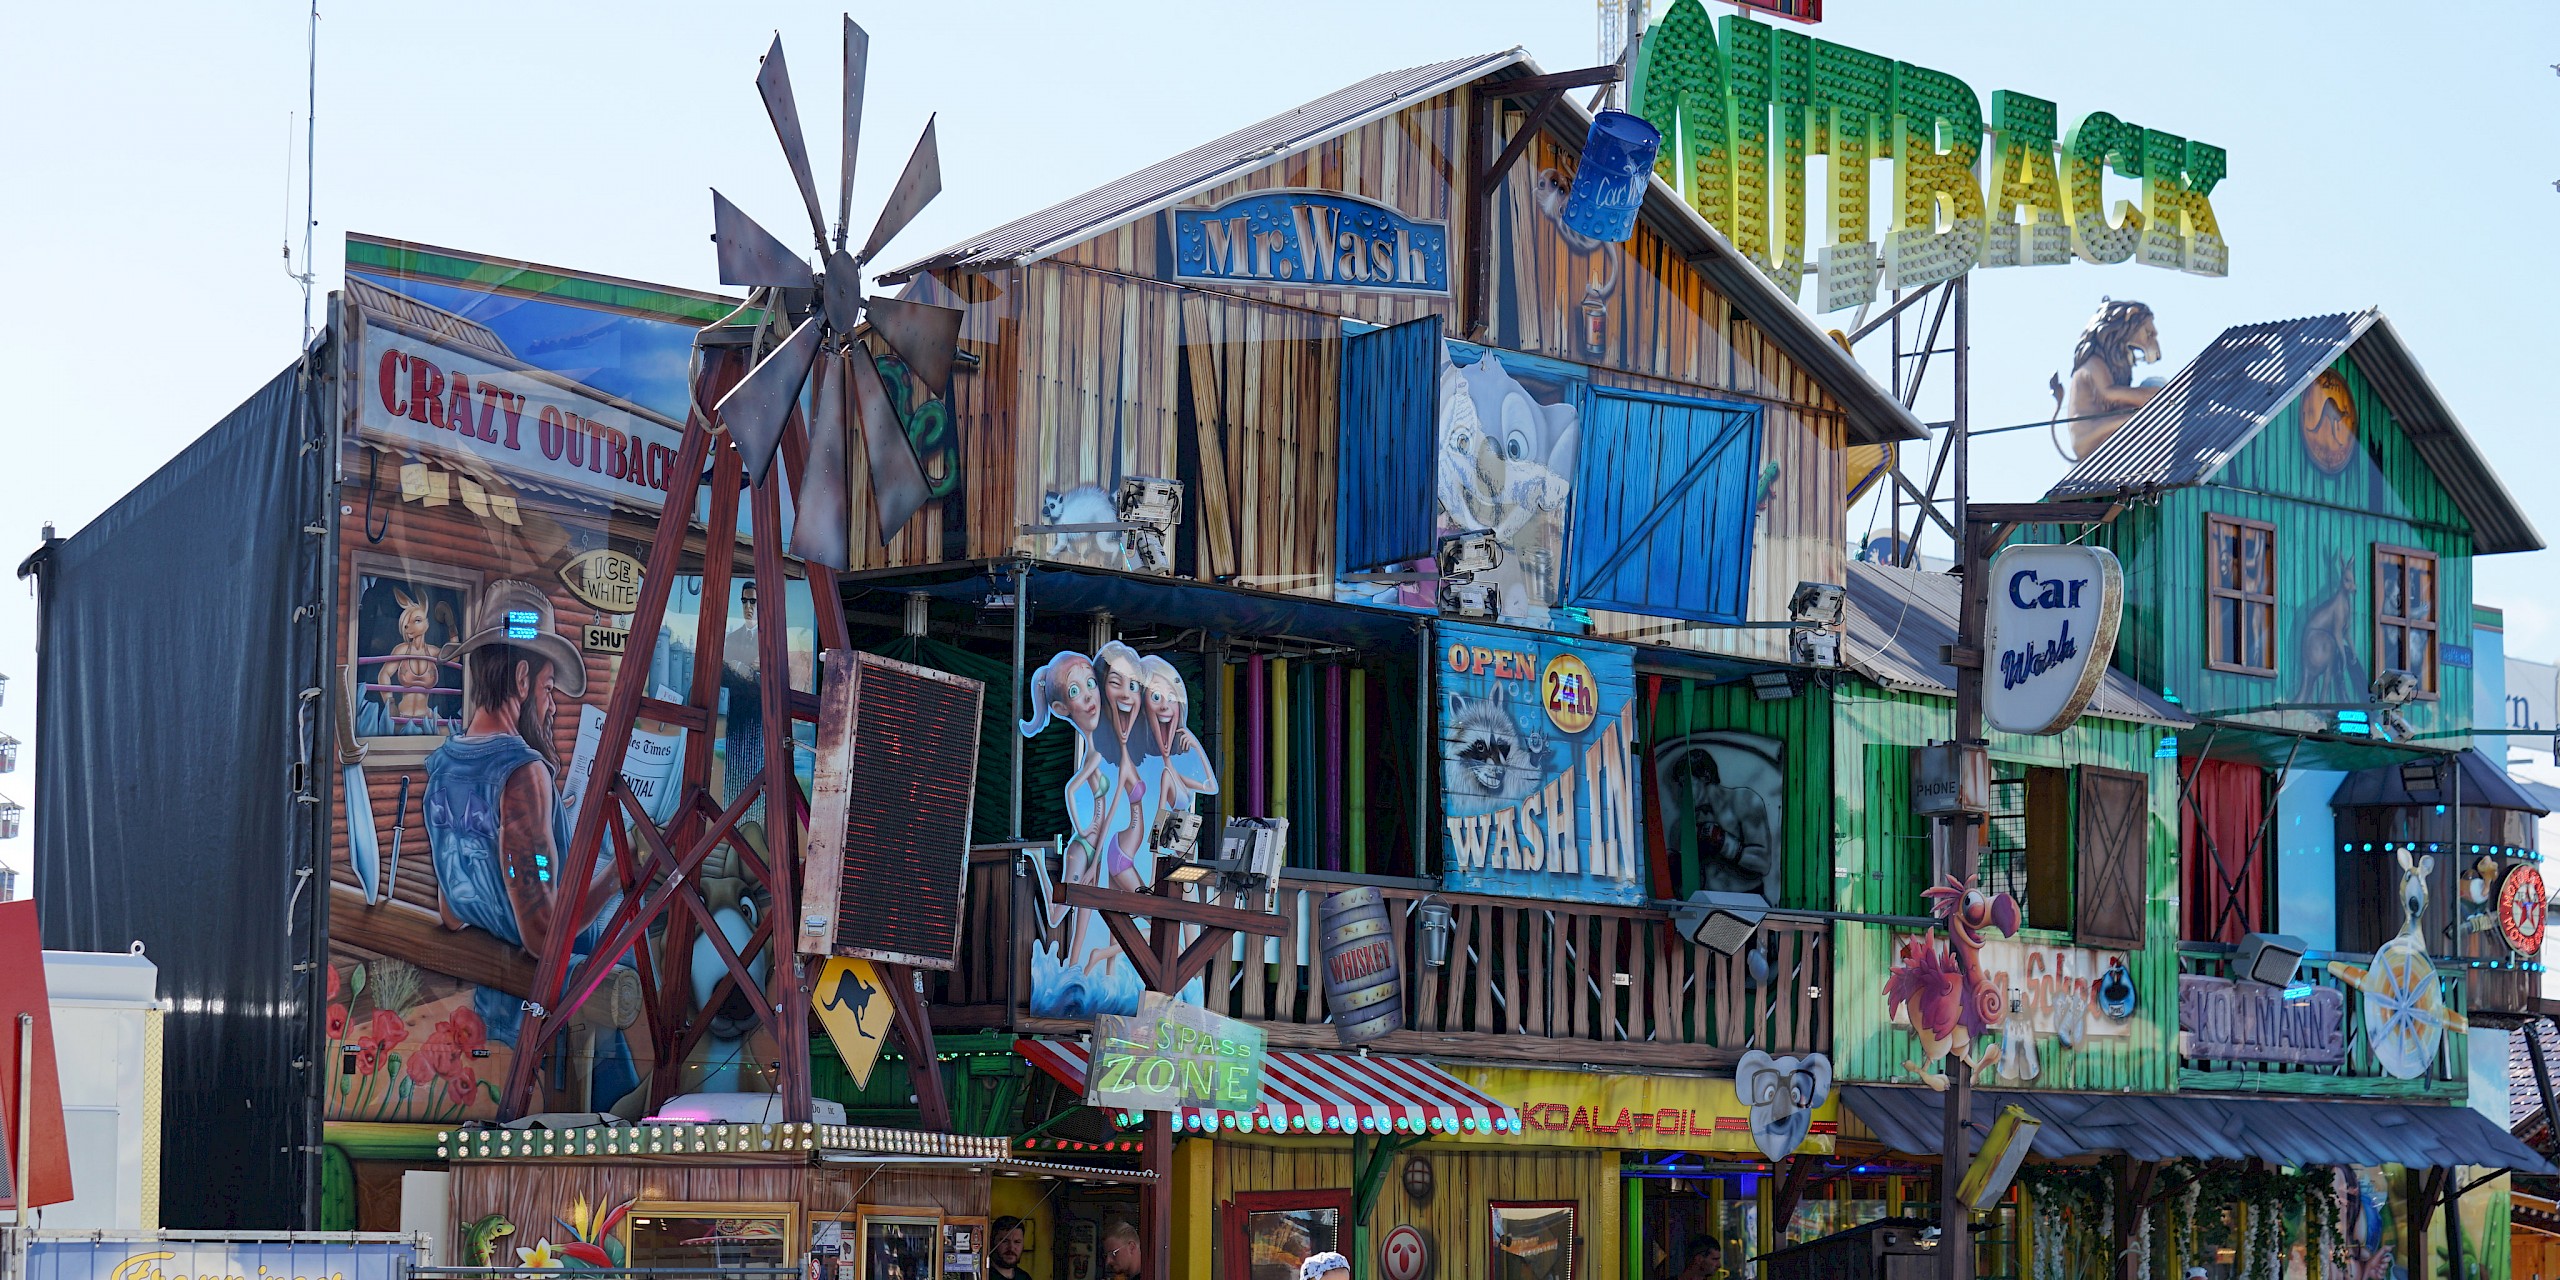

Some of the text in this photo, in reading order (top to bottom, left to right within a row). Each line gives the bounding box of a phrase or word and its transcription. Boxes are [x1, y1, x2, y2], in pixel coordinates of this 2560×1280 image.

[379, 348, 679, 492] CRAZY OUTBACK
[595, 556, 631, 583] ICE
[2009, 570, 2088, 610] Car
[587, 579, 635, 605] WHITE
[1447, 642, 1537, 681] OPEN
[2000, 619, 2078, 691] Wash
[1548, 671, 1593, 715] 24h
[643, 739, 671, 757] Times
[1447, 697, 1637, 882] WASH IN
[1916, 781, 1956, 797] PHONE
[1329, 940, 1391, 985] WHISKEY
[1153, 1016, 1252, 1059] SPASS
[2196, 990, 2326, 1050] KOLLMANN
[1097, 1053, 1250, 1102] ZONE
[1521, 1101, 1712, 1137] KOALA OIL
